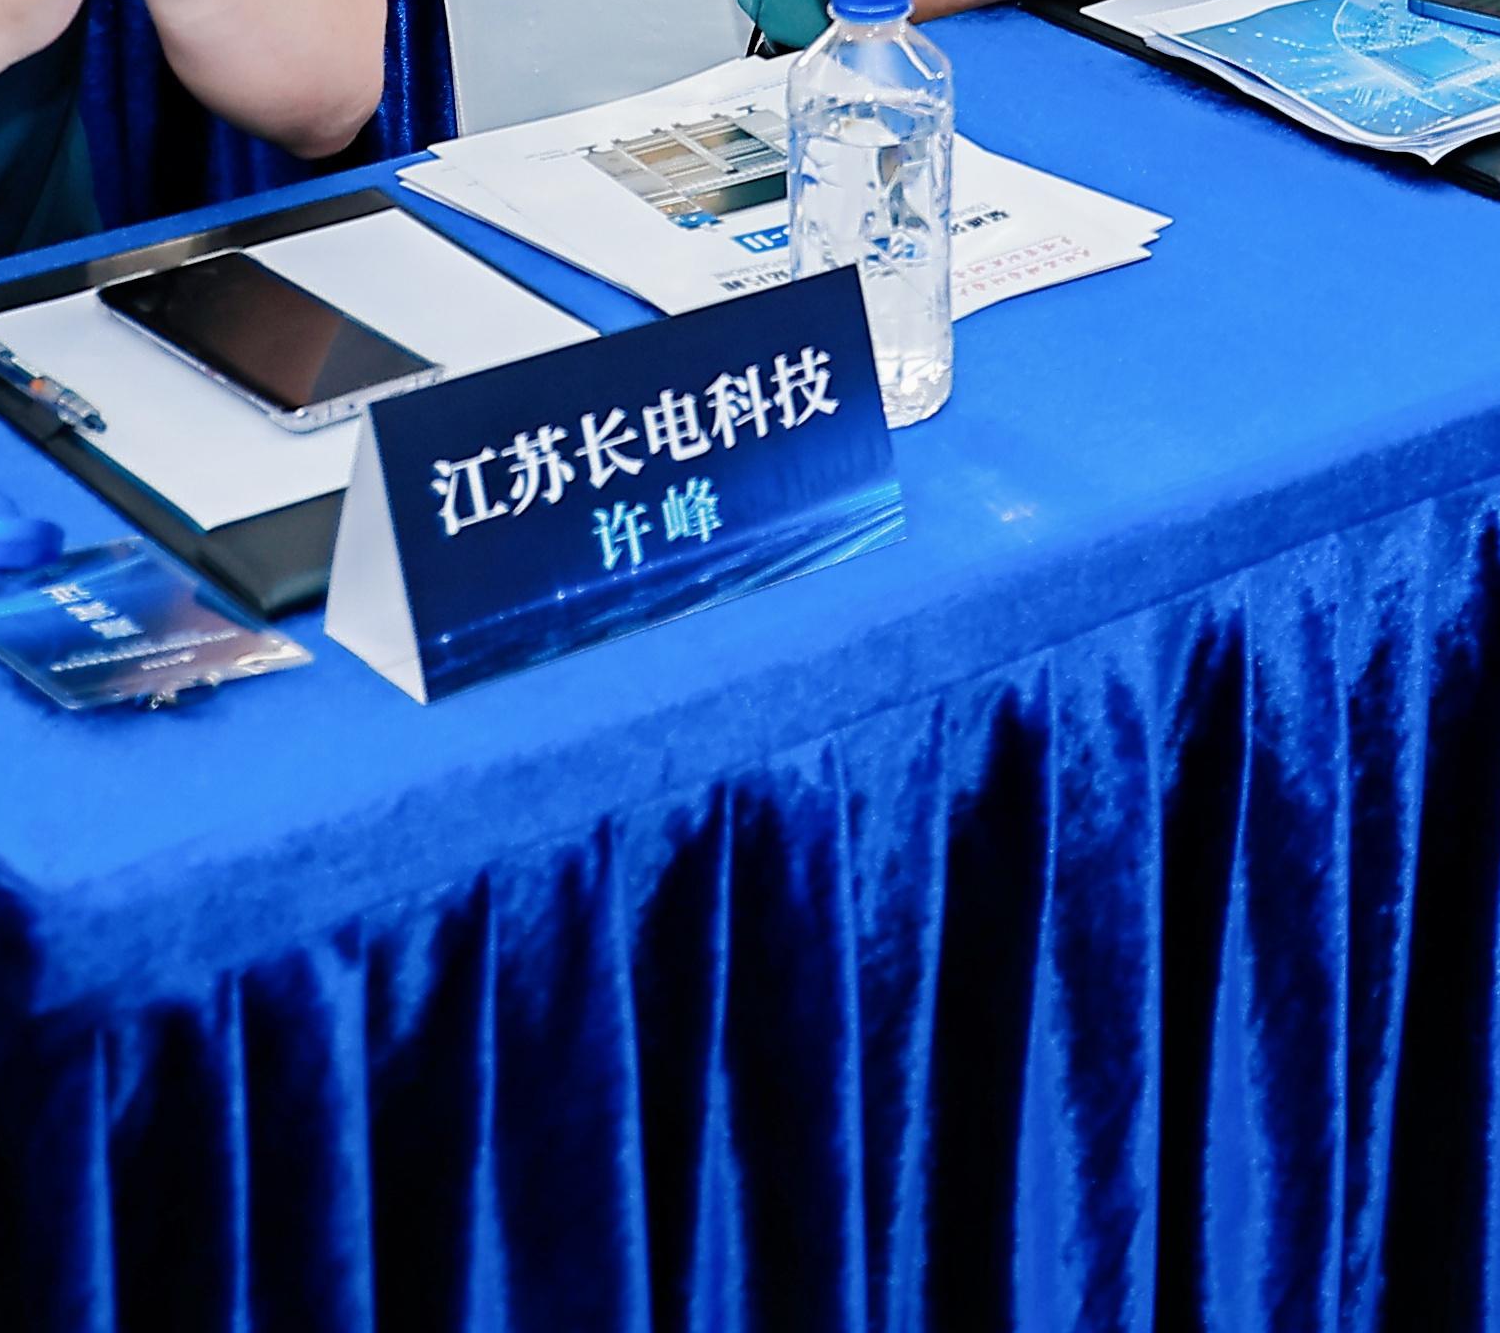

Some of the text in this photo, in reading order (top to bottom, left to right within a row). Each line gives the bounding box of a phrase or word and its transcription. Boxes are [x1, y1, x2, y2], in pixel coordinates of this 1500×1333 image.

[430, 345, 841, 535] 江苏长电科技
[591, 476, 725, 572] 许峰
